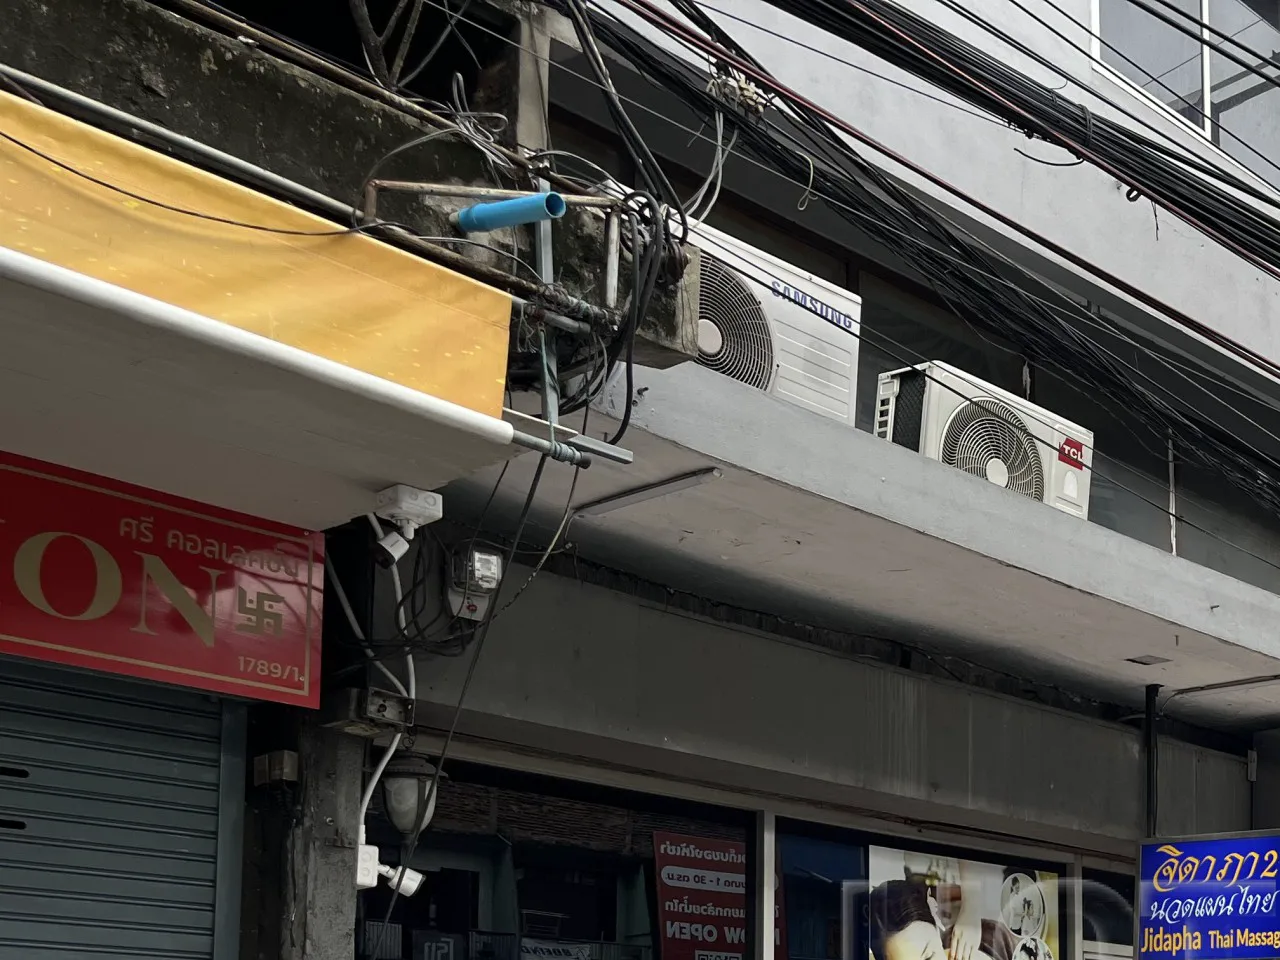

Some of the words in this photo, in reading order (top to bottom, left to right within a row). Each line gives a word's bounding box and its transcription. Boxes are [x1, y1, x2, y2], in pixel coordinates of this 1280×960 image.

[772, 281, 852, 329] SAMSUNG
[1063, 444, 1083, 461] TCL
[119, 517, 154, 543] ศรี
[0, 518, 226, 648] ON
[1141, 925, 1202, 956] Jidapha
[1208, 929, 1234, 949] Thai
